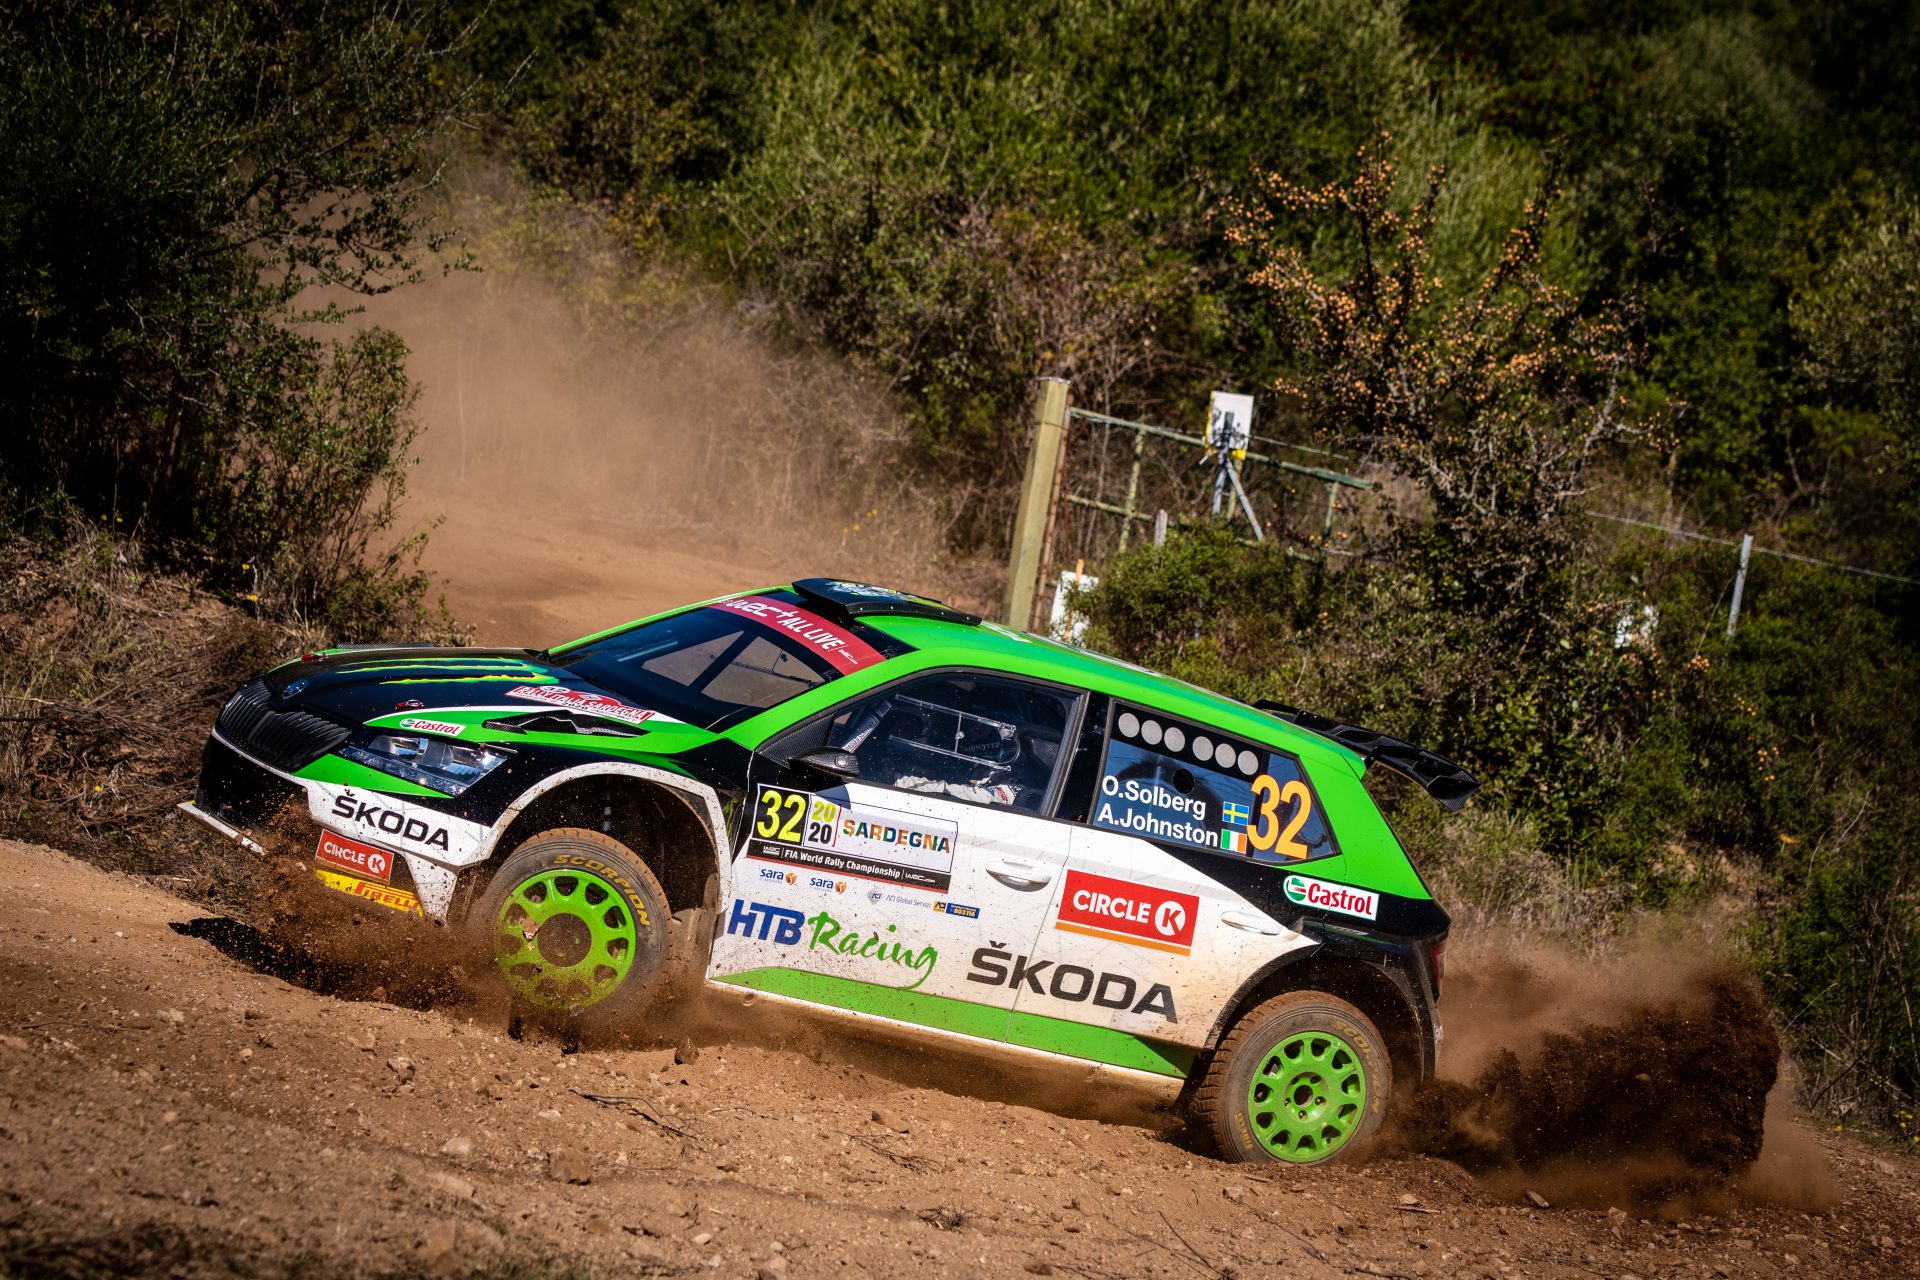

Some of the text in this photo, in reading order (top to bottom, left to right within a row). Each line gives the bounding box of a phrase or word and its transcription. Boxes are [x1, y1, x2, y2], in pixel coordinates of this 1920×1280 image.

[780, 616, 809, 634] ALL
[802, 628, 843, 649] LIVE
[516, 686, 553, 697] RALLY
[550, 692, 584, 706] ITALIA
[586, 701, 648, 719] SARDEGNA
[413, 720, 461, 735] Castrol
[811, 801, 836, 822] 20
[1101, 775, 1206, 820] O.Solberg
[331, 790, 449, 851] ŠKODA
[757, 789, 806, 842] 32
[1098, 803, 1219, 847] A.Johnston
[1246, 774, 1311, 859] 32
[808, 821, 833, 844] 20
[843, 819, 950, 853] SARDEGNA
[323, 841, 384, 873] CIRCLE K
[784, 850, 798, 860] FIA
[800, 853, 823, 864] World
[825, 856, 845, 868] Rally
[846, 860, 901, 879] Championship
[760, 868, 784, 880] sara
[810, 877, 834, 889] sara
[553, 854, 651, 928] SCORPION
[896, 896, 912, 905] Global
[1307, 883, 1373, 916] Castrol
[727, 898, 806, 945] HTB
[1072, 889, 1184, 934] CIRCLE K
[807, 910, 938, 989] Racing
[967, 941, 1178, 1024] ŠKODA
